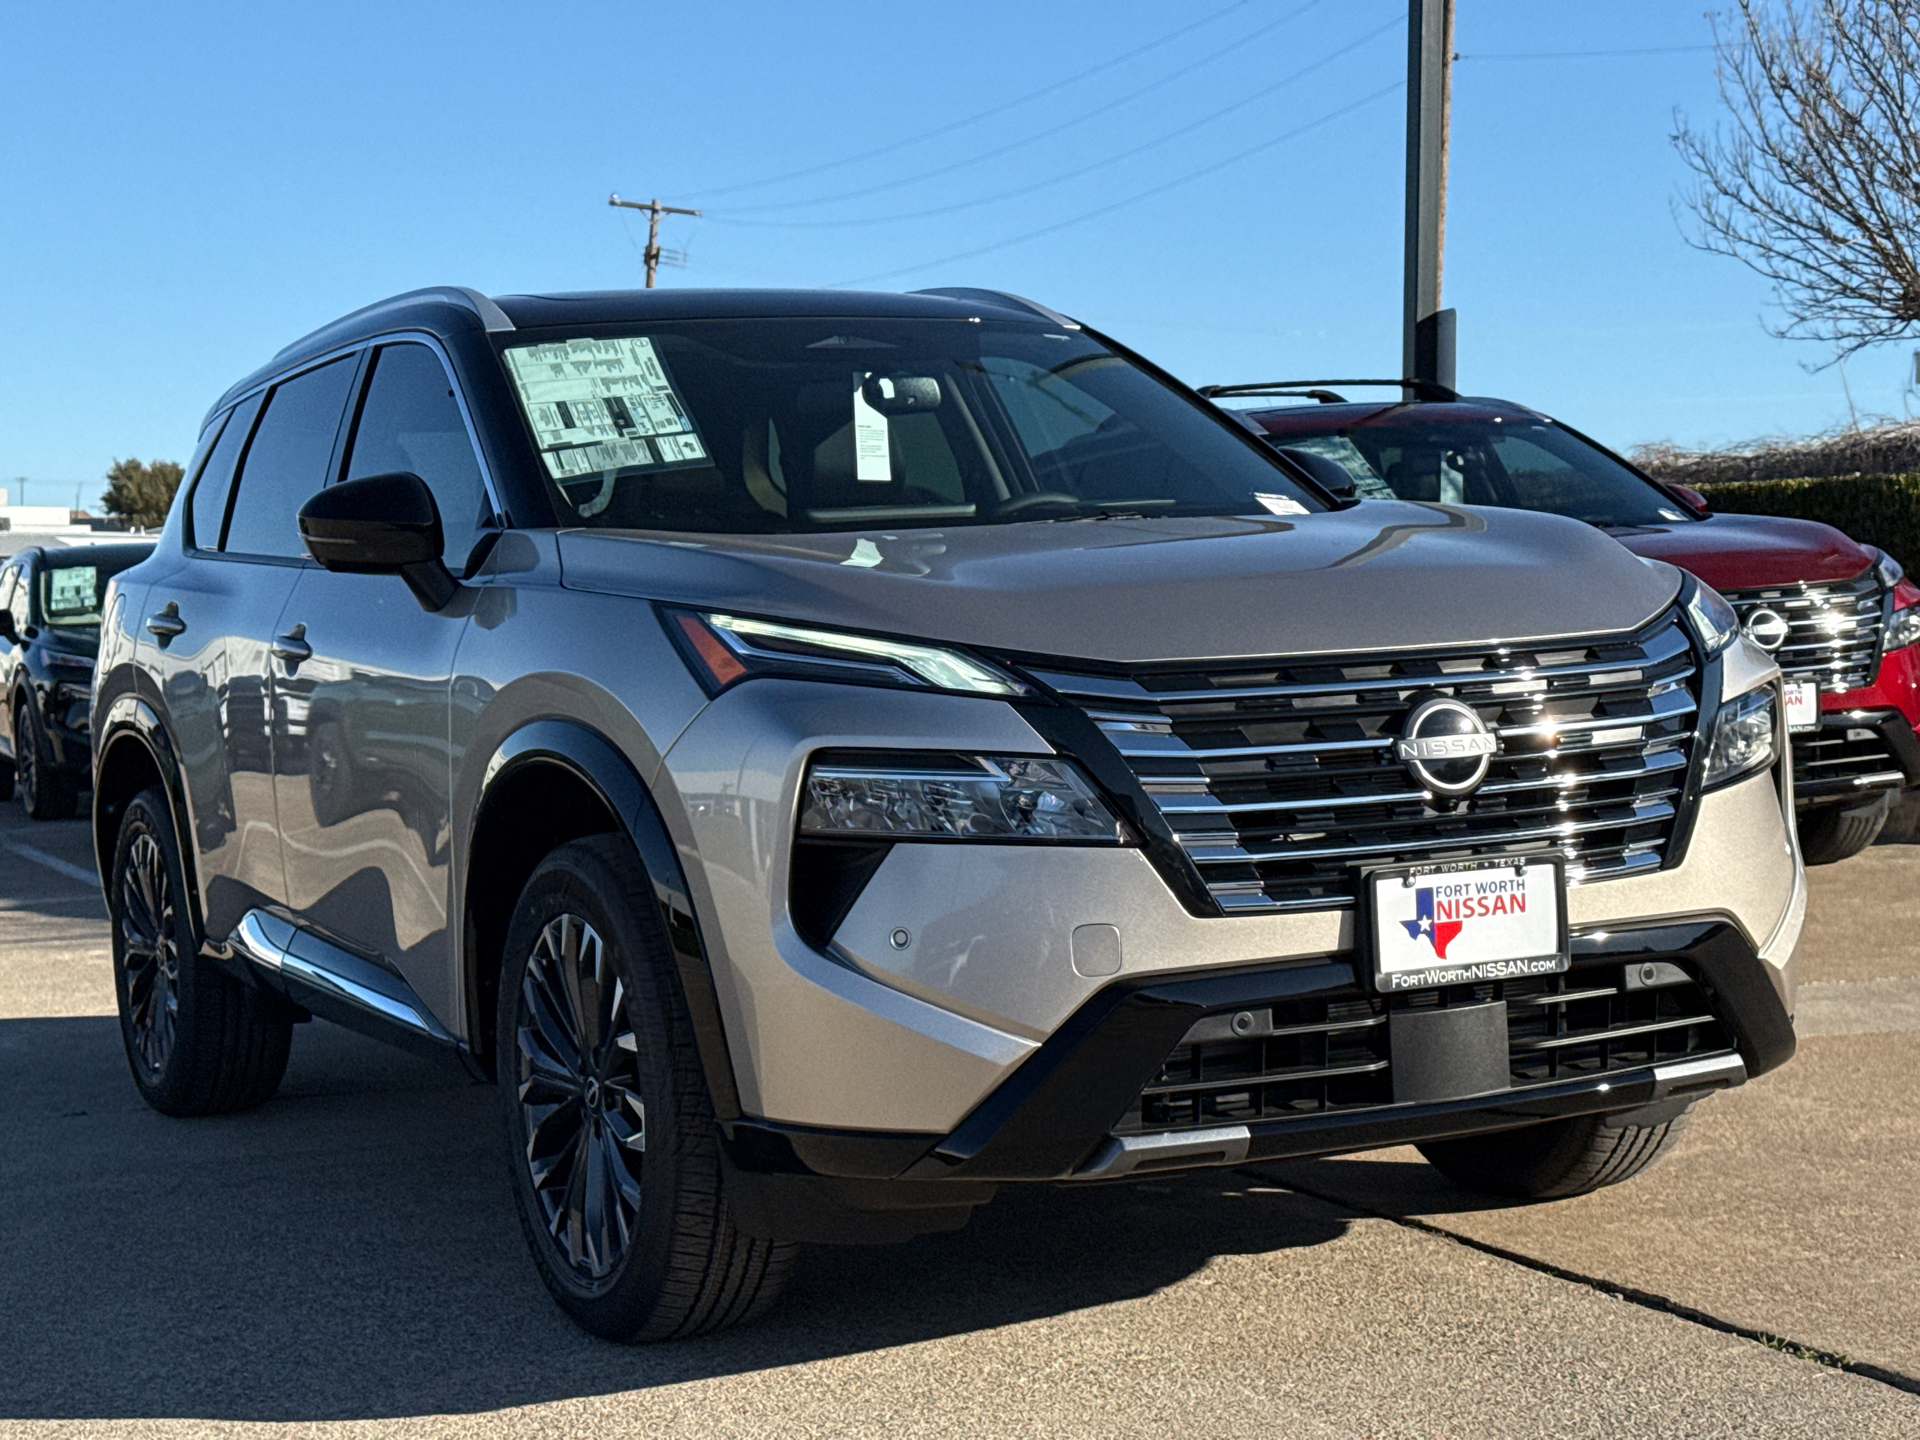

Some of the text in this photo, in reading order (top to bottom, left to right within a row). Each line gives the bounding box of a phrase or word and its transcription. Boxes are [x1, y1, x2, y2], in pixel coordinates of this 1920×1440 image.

[1400, 735, 1495, 758] NISSAN
[1409, 857, 1526, 877] FORT WORTH TEXAS
[1435, 878, 1526, 899] FORT WORTH
[1436, 892, 1526, 921] NISSAN
